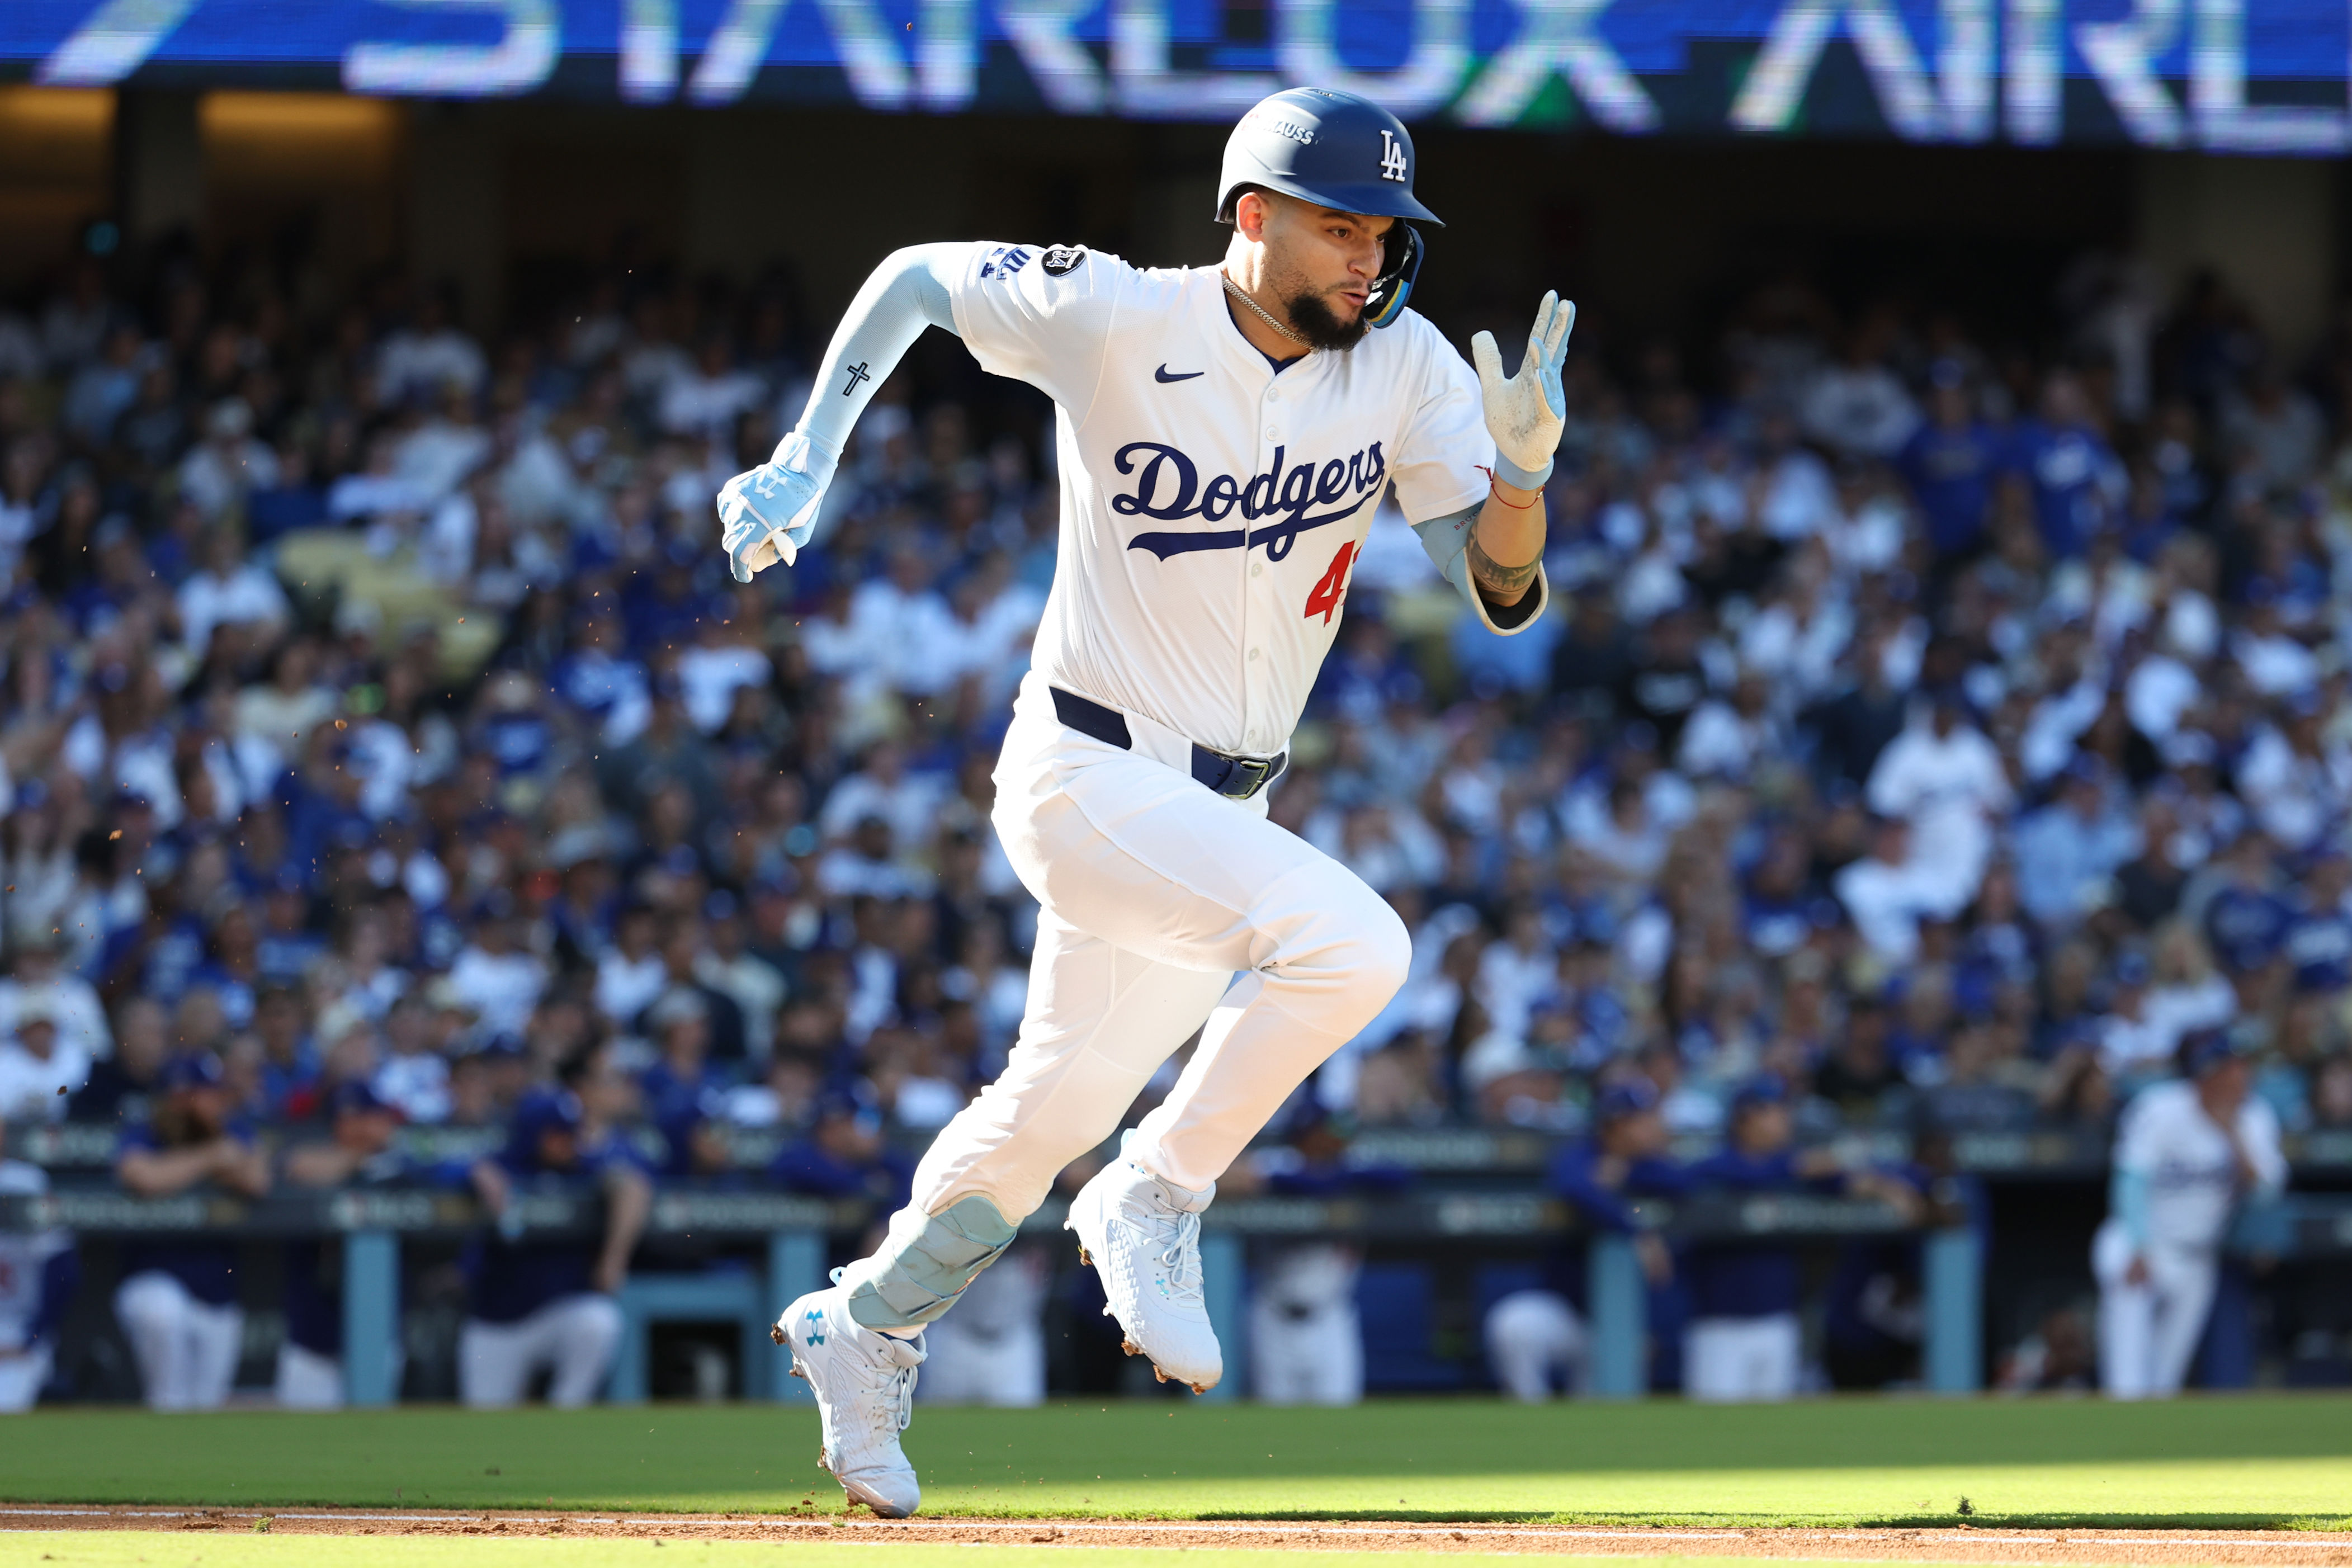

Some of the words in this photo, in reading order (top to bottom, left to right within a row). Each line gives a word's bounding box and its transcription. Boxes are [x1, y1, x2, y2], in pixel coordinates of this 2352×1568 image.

[1261, 119, 1315, 145] RAUSS
[1381, 129, 1407, 182] LA
[1112, 440, 1385, 562] Dodgers
[1454, 508, 1481, 531] BRUC
[1304, 539, 1364, 627] 4
